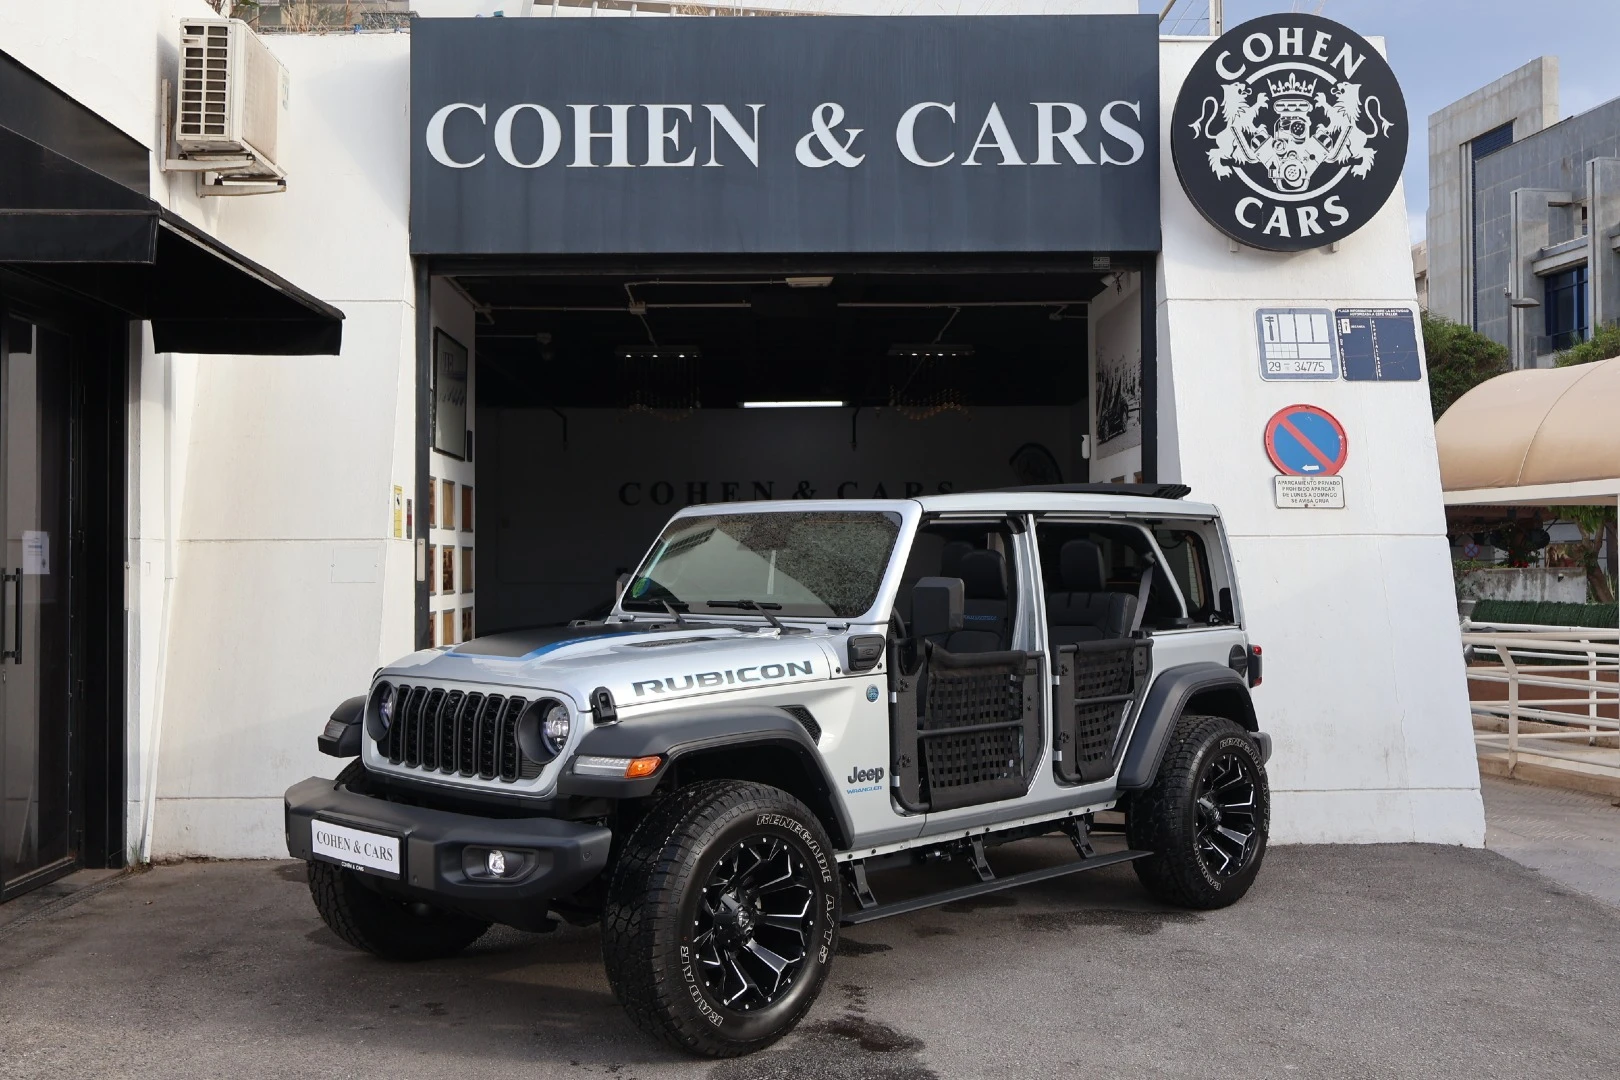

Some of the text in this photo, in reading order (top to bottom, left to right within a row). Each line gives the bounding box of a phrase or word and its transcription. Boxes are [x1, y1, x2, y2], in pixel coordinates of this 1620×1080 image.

[1215, 27, 1366, 81] COHEN
[425, 101, 1146, 169] COHEN & CARS
[1235, 195, 1350, 238] CARS
[1268, 362, 1325, 372] 29 34775
[618, 481, 775, 506] COHEN
[632, 660, 813, 697] RUBICON
[847, 786, 882, 794] WRANGLER
[848, 766, 884, 784] Jeep
[316, 830, 393, 862] COHEN & CARS
[680, 946, 724, 1027] RADAR
[756, 814, 832, 883] RENEGADE
